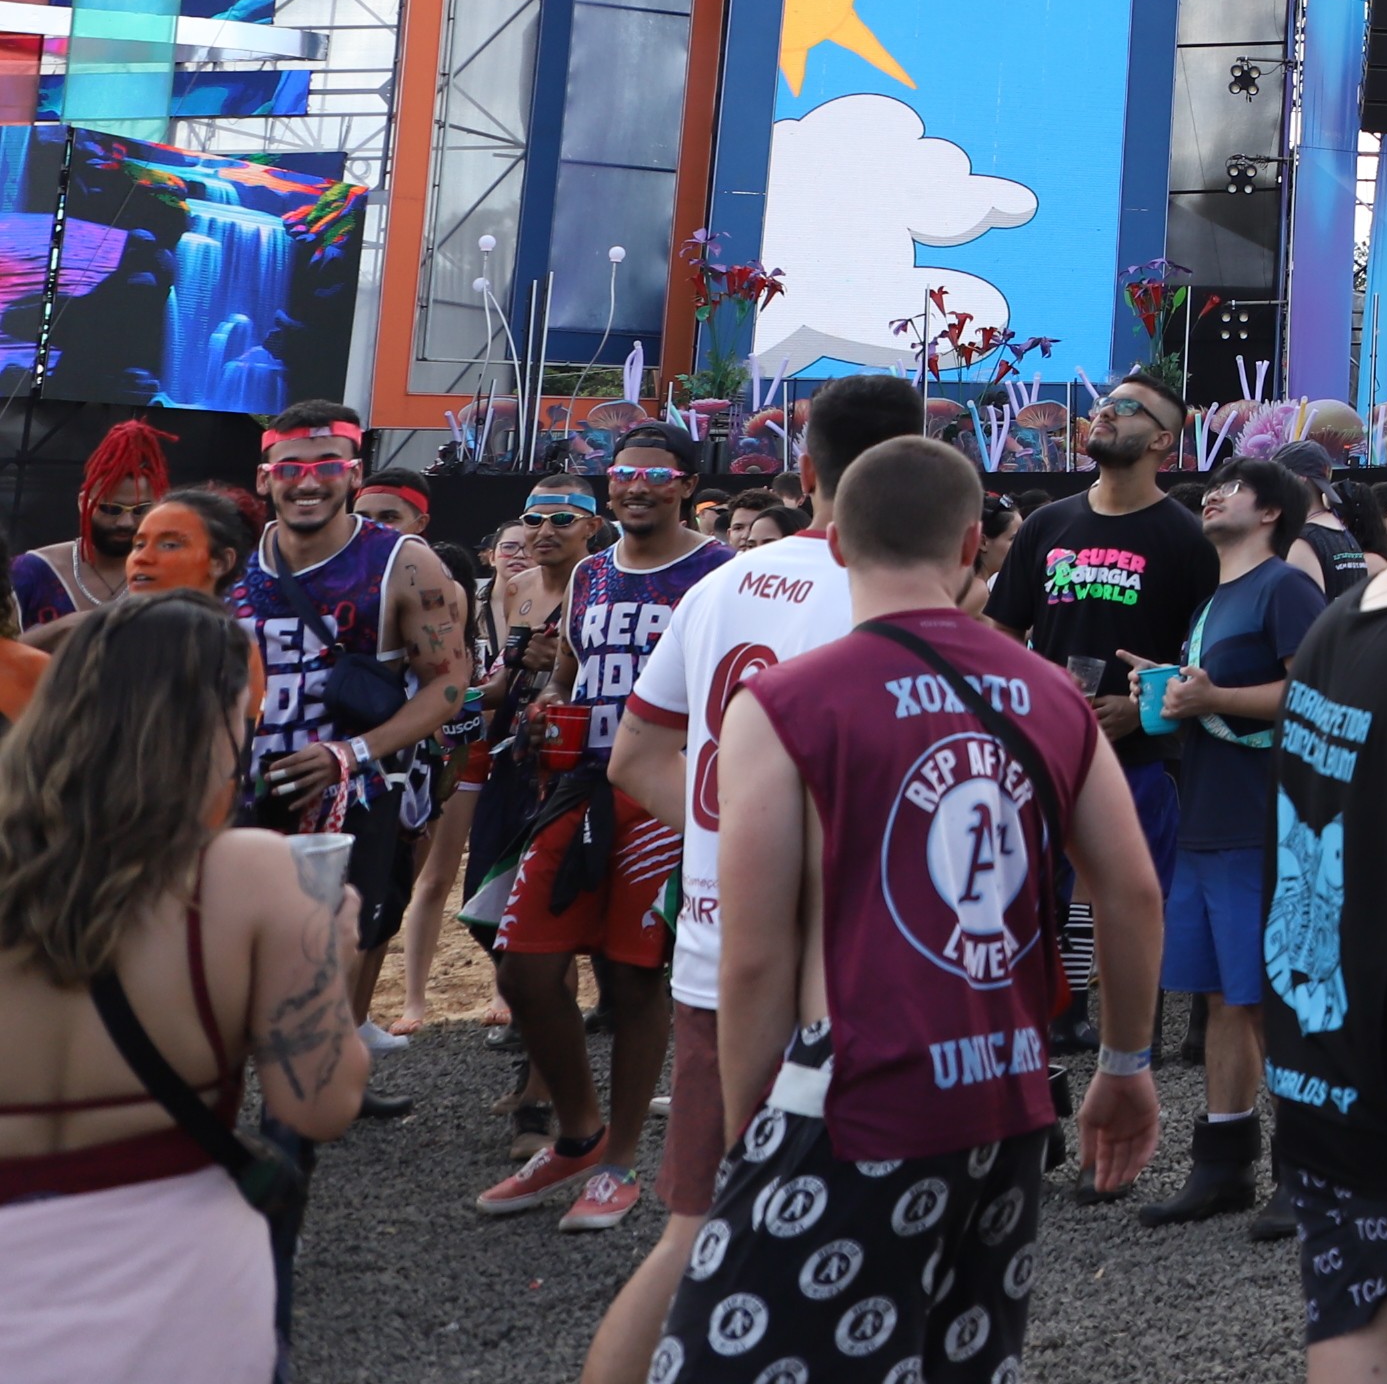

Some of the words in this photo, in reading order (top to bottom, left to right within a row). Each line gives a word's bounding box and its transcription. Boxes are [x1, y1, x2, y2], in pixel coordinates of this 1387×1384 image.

[1075, 548, 1146, 573] SUPER
[738, 571, 814, 604] MEMO
[1075, 583, 1138, 605] WORLD
[581, 602, 672, 650] REP
